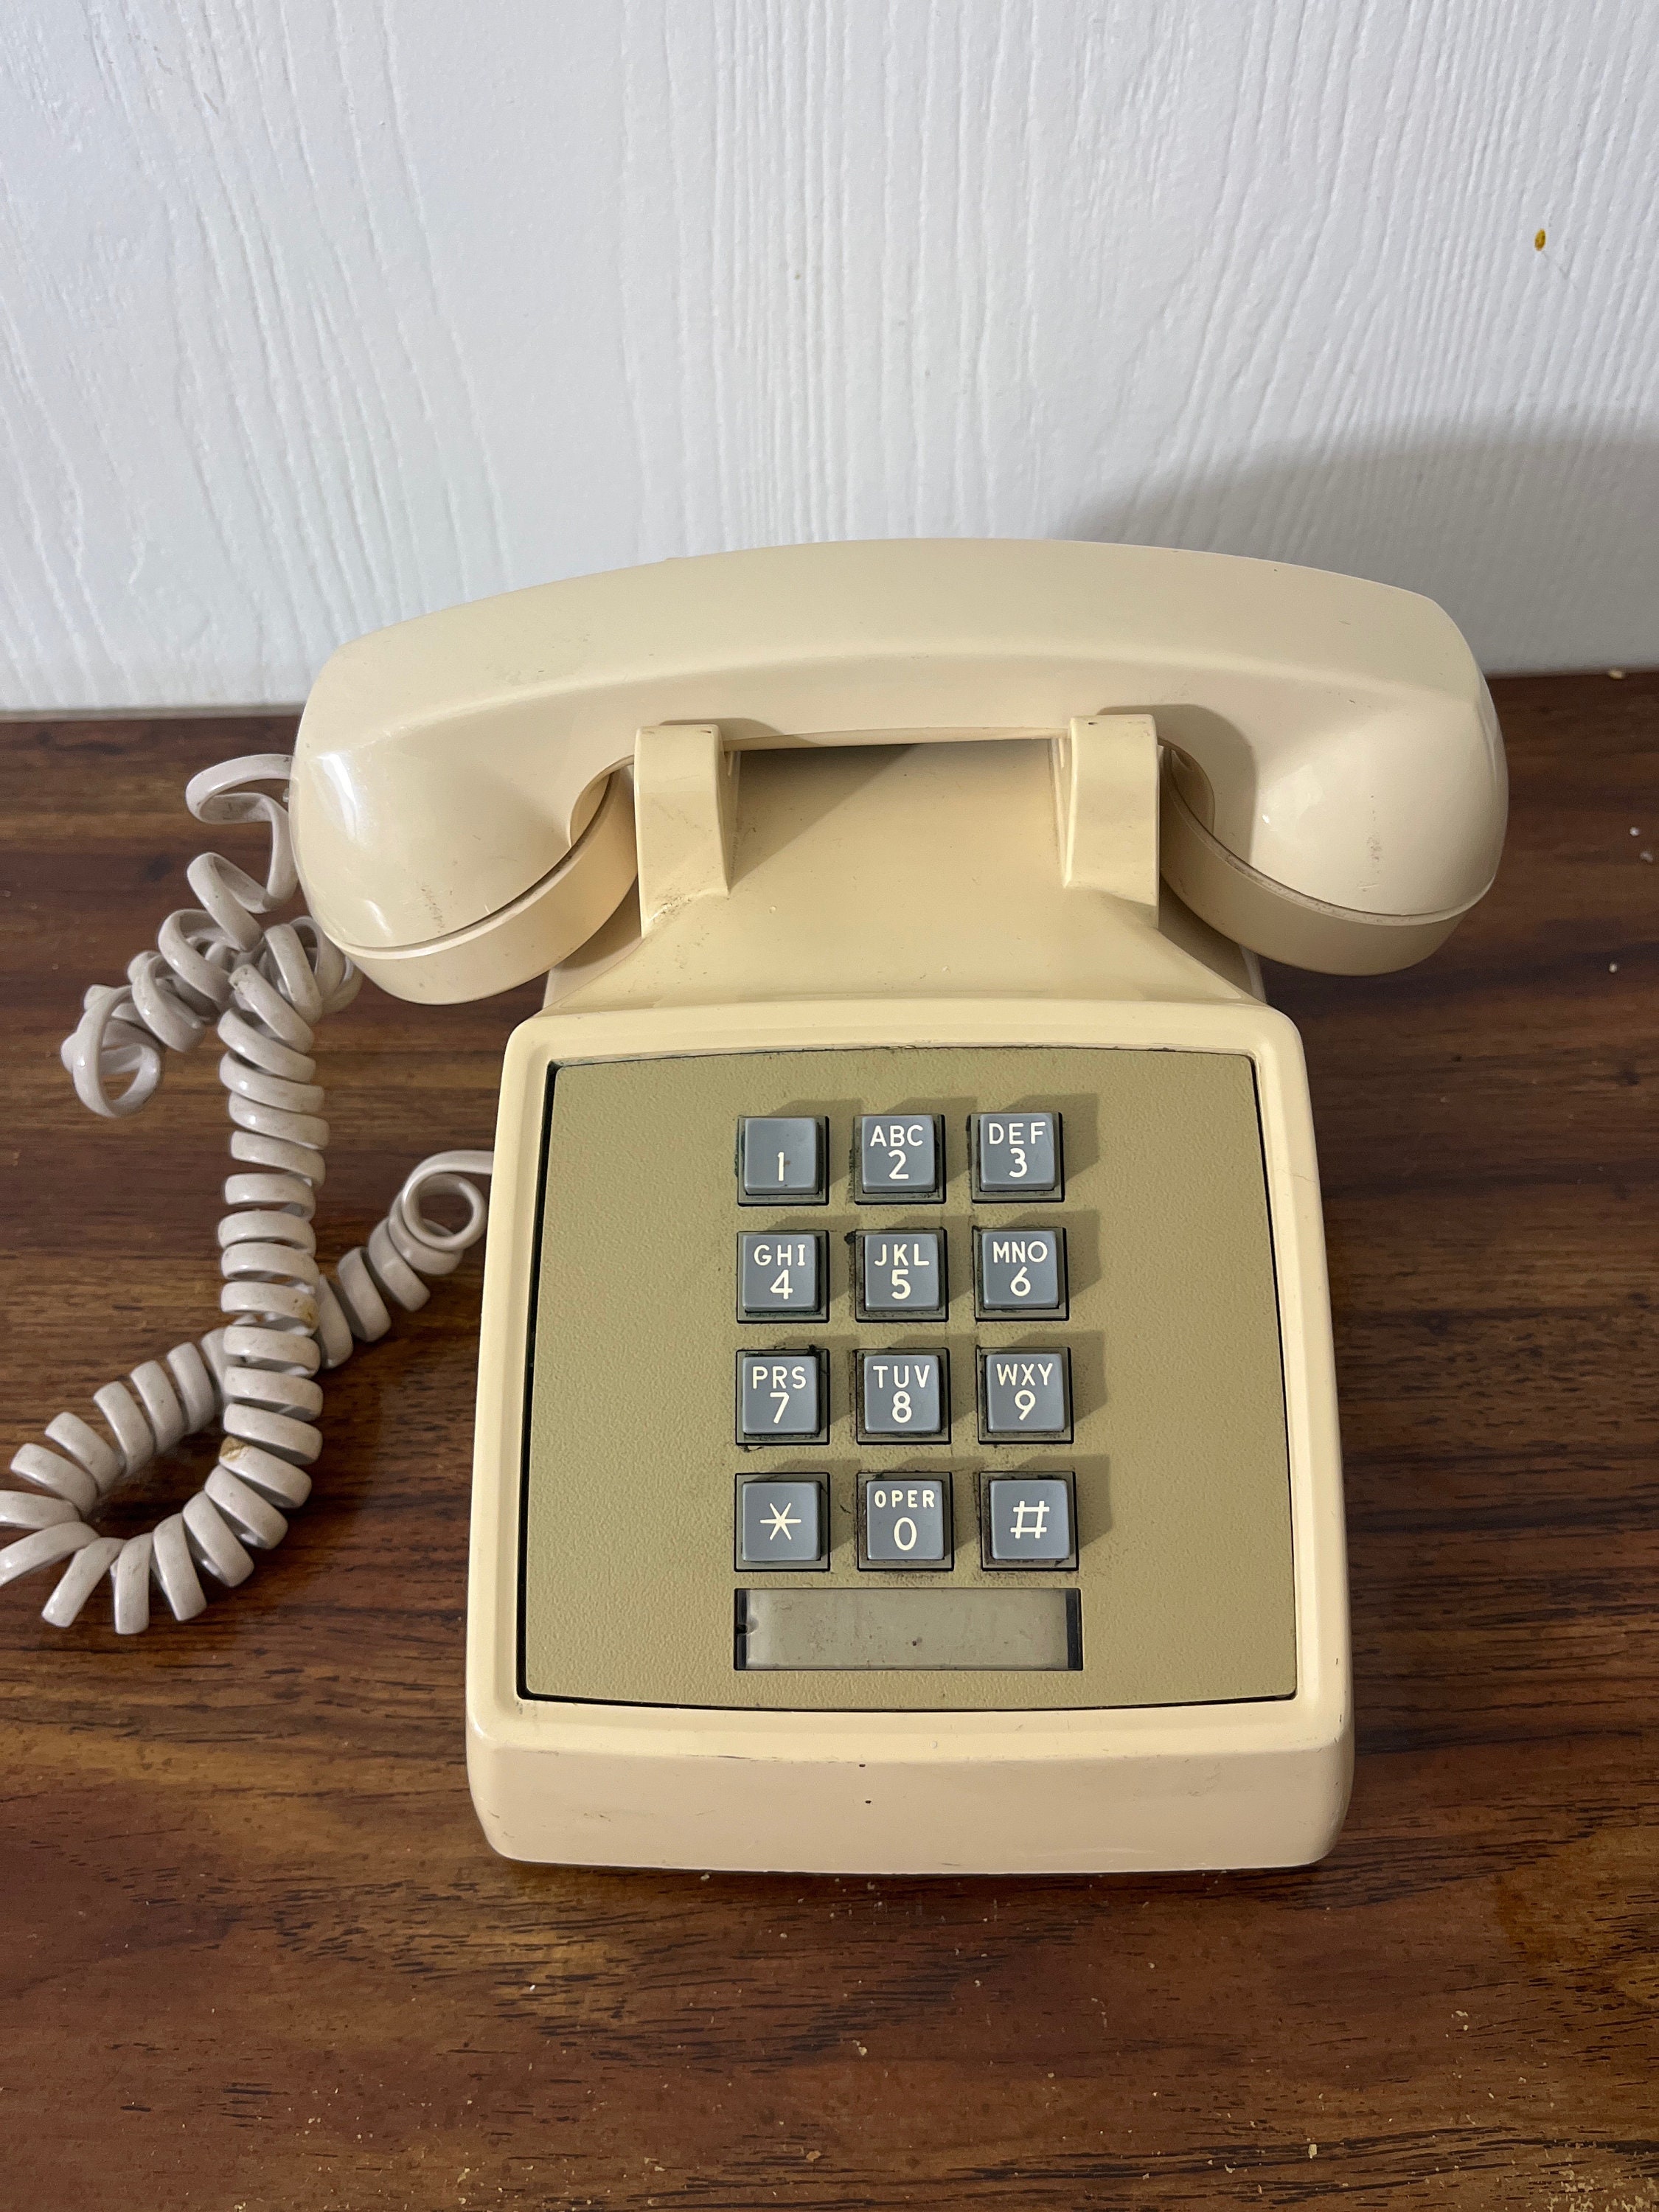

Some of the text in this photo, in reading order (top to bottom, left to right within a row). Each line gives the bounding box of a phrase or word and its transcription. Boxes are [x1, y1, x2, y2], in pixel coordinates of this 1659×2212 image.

[870, 1125, 923, 1147] ABC
[990, 1122, 1046, 1144] DEF
[778, 1152, 784, 1181] 1
[888, 1150, 908, 1179] 2
[1009, 1148, 1027, 1178] 3
[754, 1245, 805, 1266] GHI
[874, 1244, 929, 1266] JKL
[993, 1241, 1048, 1263] MNO
[771, 1270, 793, 1299] 4
[892, 1269, 911, 1299] 5
[1010, 1267, 1031, 1296] 6
[753, 1366, 806, 1388] PRS
[873, 1365, 930, 1388] TUV
[997, 1363, 1053, 1385] WXY
[770, 1392, 789, 1423] 7
[892, 1391, 911, 1423] 8
[1015, 1390, 1035, 1420] 9
[874, 1490, 934, 1508] OPER
[894, 1517, 917, 1551] 0
[1010, 1500, 1049, 1539] #
